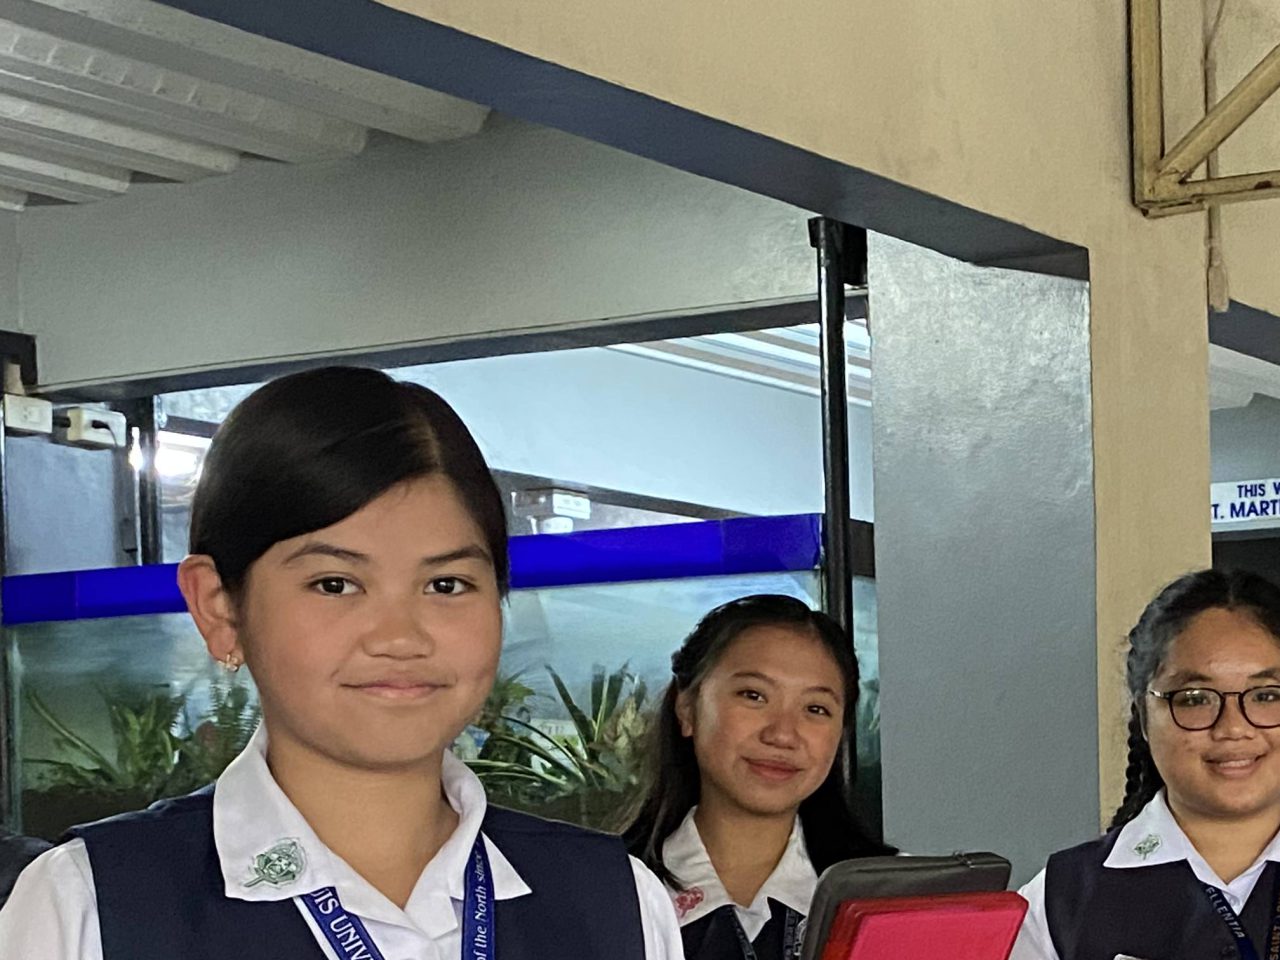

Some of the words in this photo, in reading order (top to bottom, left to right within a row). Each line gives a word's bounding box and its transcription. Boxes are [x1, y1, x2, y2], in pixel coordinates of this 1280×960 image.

[1237, 484, 1266, 498] THIS
[1211, 503, 1224, 519] T.
[475, 886, 487, 922] North
[1205, 886, 1246, 939] ELLENTIA
[474, 925, 487, 944] the
